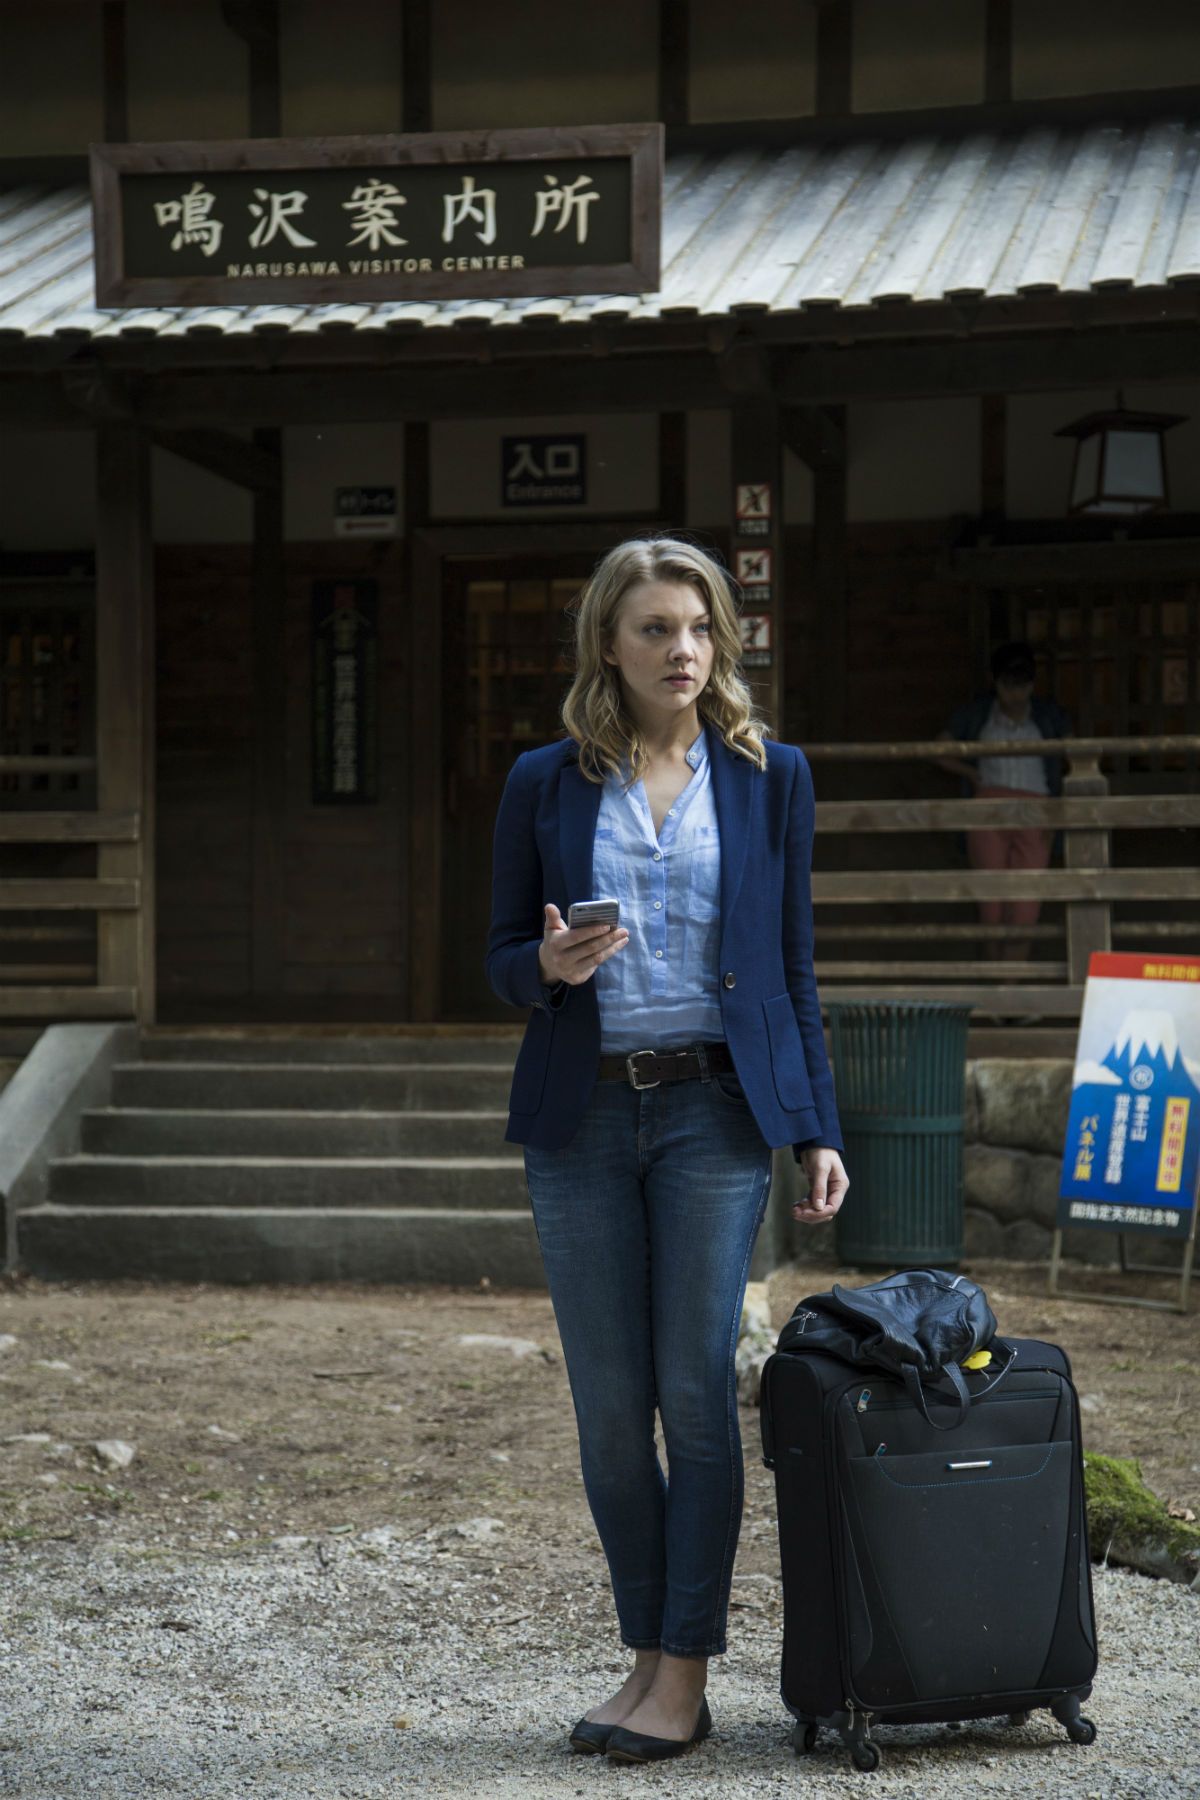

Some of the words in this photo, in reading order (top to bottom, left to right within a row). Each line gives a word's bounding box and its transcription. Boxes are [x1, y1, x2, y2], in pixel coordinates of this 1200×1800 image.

[154, 175, 600, 257] 鳴沢案内所
[227, 261, 340, 278] NARUSAWA
[348, 258, 433, 275] VISITOR
[442, 254, 525, 272] CENTER
[507, 443, 580, 479] 入口
[507, 481, 581, 500] Entrance
[1130, 1094, 1151, 1142] 富士山
[1069, 1201, 1180, 1227] 国指定天然記念物
